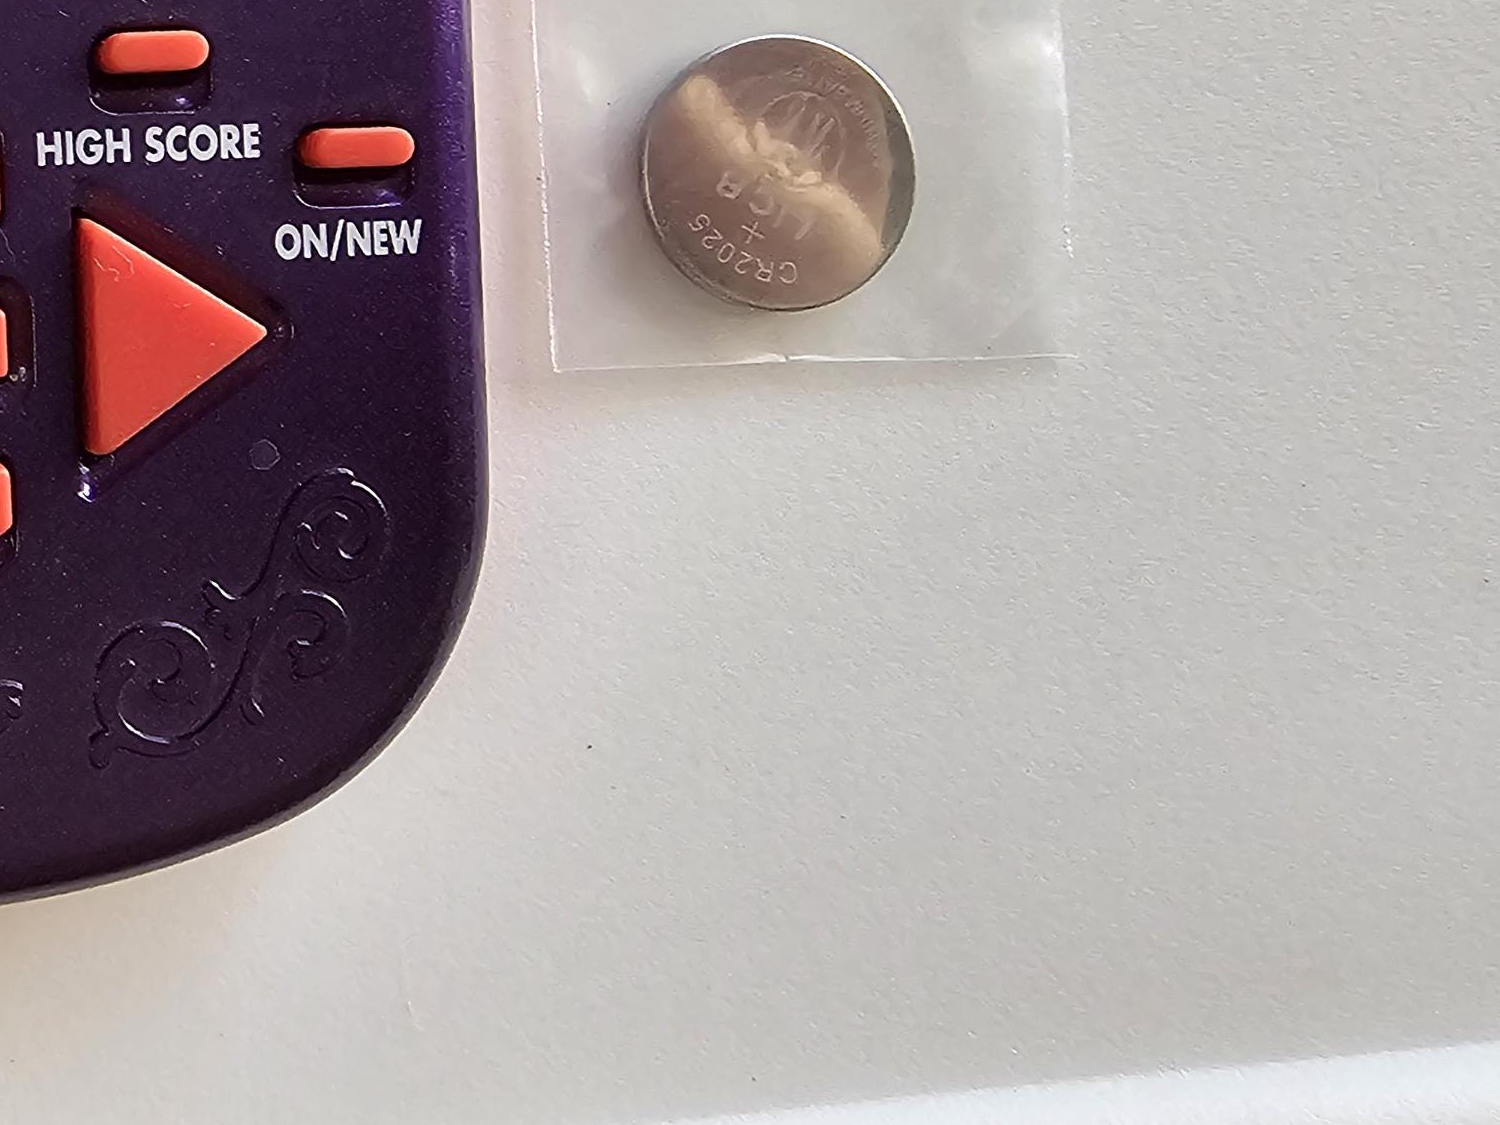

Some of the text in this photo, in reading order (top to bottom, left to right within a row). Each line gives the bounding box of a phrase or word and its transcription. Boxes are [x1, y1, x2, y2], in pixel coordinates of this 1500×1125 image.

[35, 123, 261, 167] HIGH SCORE
[274, 218, 422, 262] ON/NEW
[688, 213, 798, 284] CR2025
